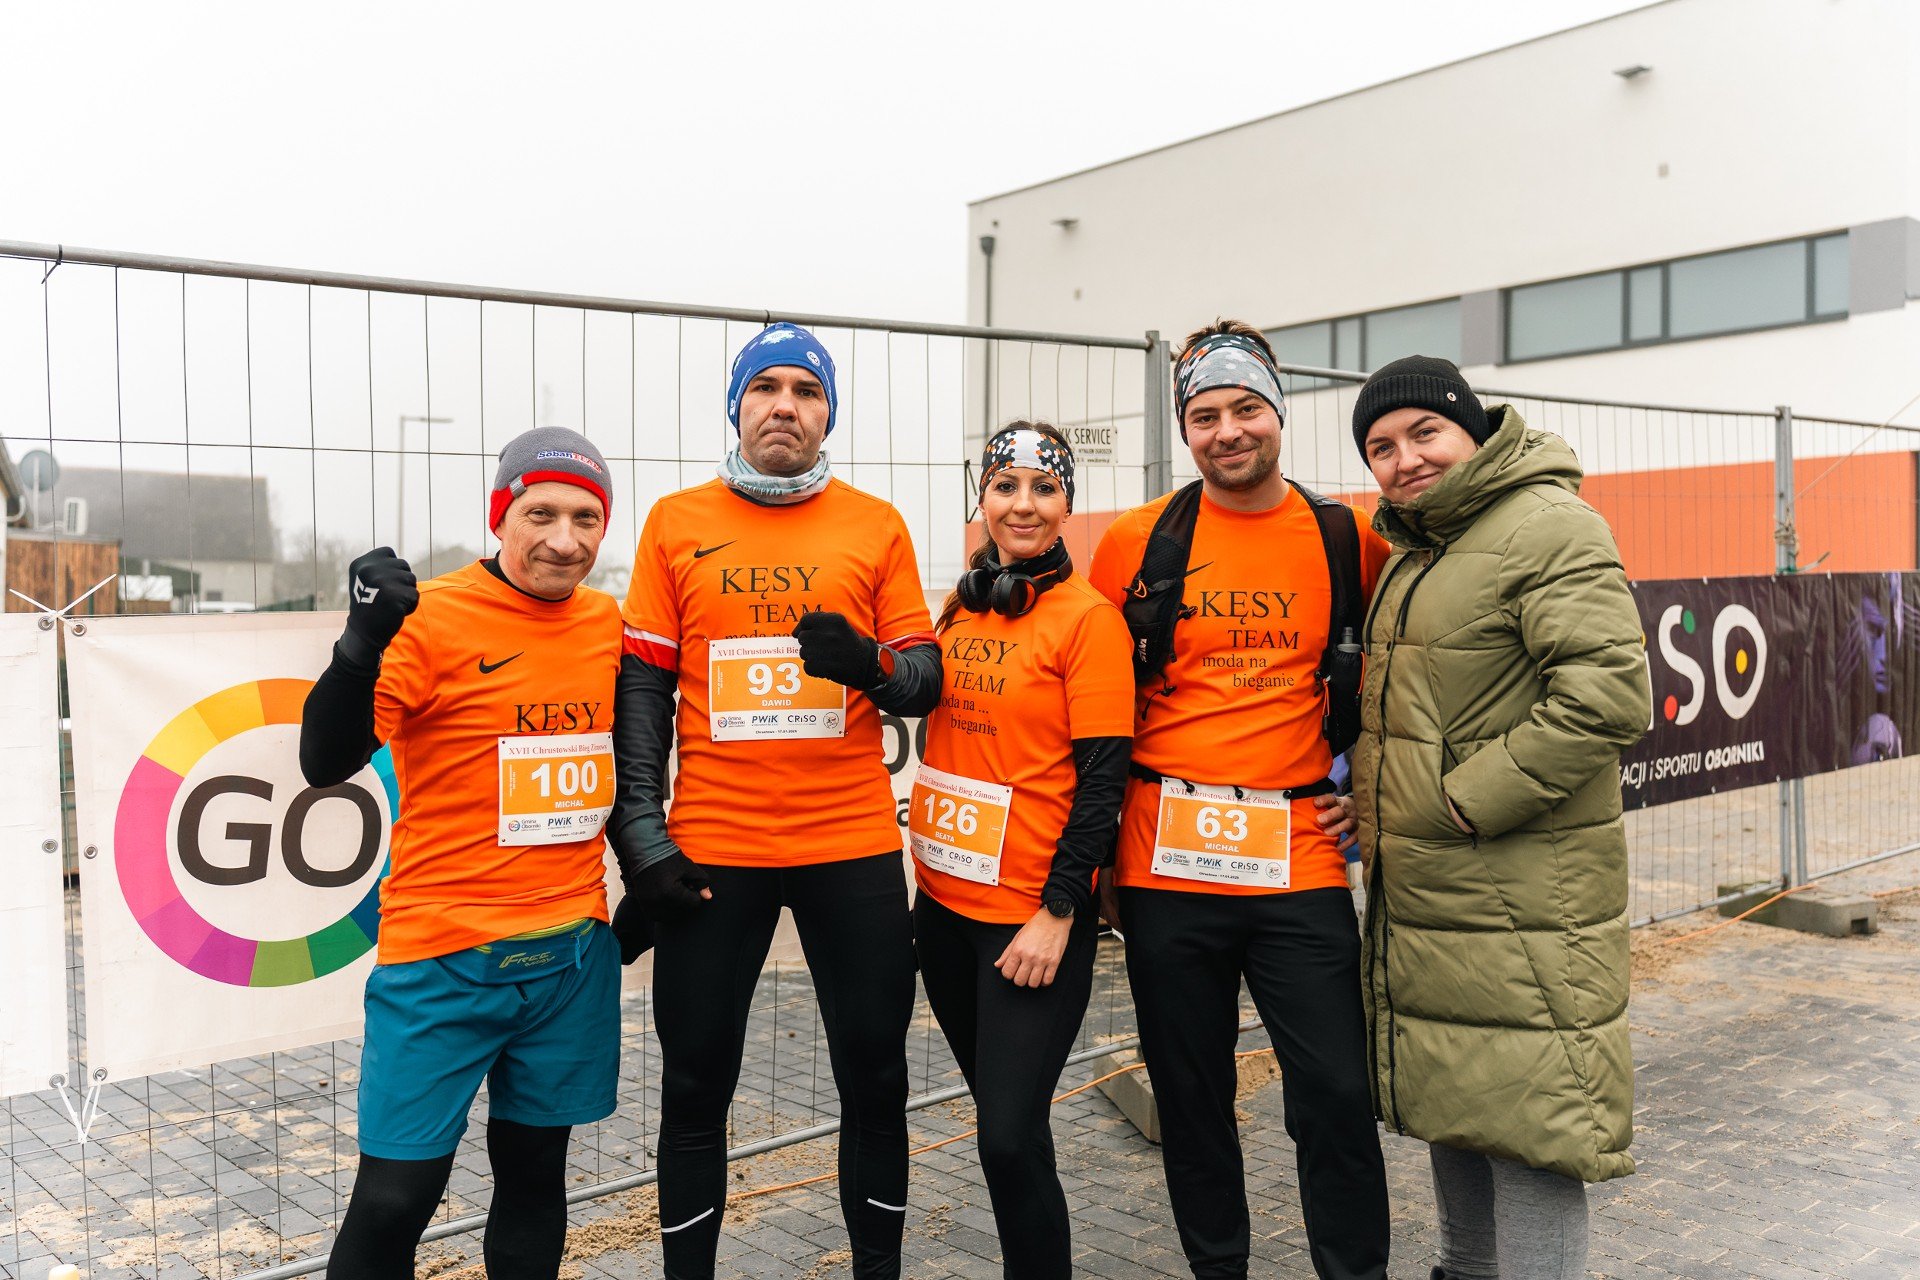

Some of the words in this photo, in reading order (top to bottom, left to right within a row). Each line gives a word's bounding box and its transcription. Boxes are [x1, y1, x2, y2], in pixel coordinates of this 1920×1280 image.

[1074, 428, 1111, 445] SERVICE
[719, 566, 820, 599] KĘSY
[1200, 591, 1299, 625] KĘSY
[1227, 629, 1300, 650] TEAM
[717, 649, 735, 657] XVII
[736, 648, 785, 656] Chrustowski
[786, 646, 800, 655] Bie
[946, 637, 1018, 668] KĘSY
[1202, 654, 1244, 668] moda
[1250, 656, 1267, 668] na
[1643, 603, 1767, 731] SO
[747, 662, 802, 696] 93
[953, 670, 1007, 696] TEAM
[1233, 673, 1295, 691] bieganie
[761, 699, 792, 707] DAWID
[938, 694, 960, 709] oda
[963, 699, 975, 711] na
[514, 702, 601, 736] KĘSY
[751, 715, 778, 724] PWiK
[787, 714, 817, 723] CRiSO
[950, 714, 998, 737] bieganie
[508, 747, 530, 755] XVII
[532, 745, 578, 755] Chrustowski
[578, 744, 590, 754] Bieg
[1619, 760, 1647, 789] ACJI
[1654, 751, 1701, 780] SPORTU
[1704, 740, 1765, 771] OBORNIKI
[530, 760, 598, 797] 100
[928, 777, 957, 792] Chrustowski
[958, 786, 973, 797] Bieg
[974, 788, 1002, 803] Zimowy
[555, 799, 585, 809] MICHAŁ
[1252, 796, 1281, 806] Zimowy
[547, 816, 572, 827] PWiK
[924, 793, 979, 836] 126
[177, 775, 382, 888] GO
[1196, 806, 1248, 842] 63
[935, 831, 955, 843] BEATA
[927, 843, 944, 856] PWiK
[1205, 843, 1240, 853] MICHAŁ
[949, 851, 973, 864] CRiSO
[1196, 856, 1222, 867] PWiK
[1230, 861, 1259, 871] CRiSO
